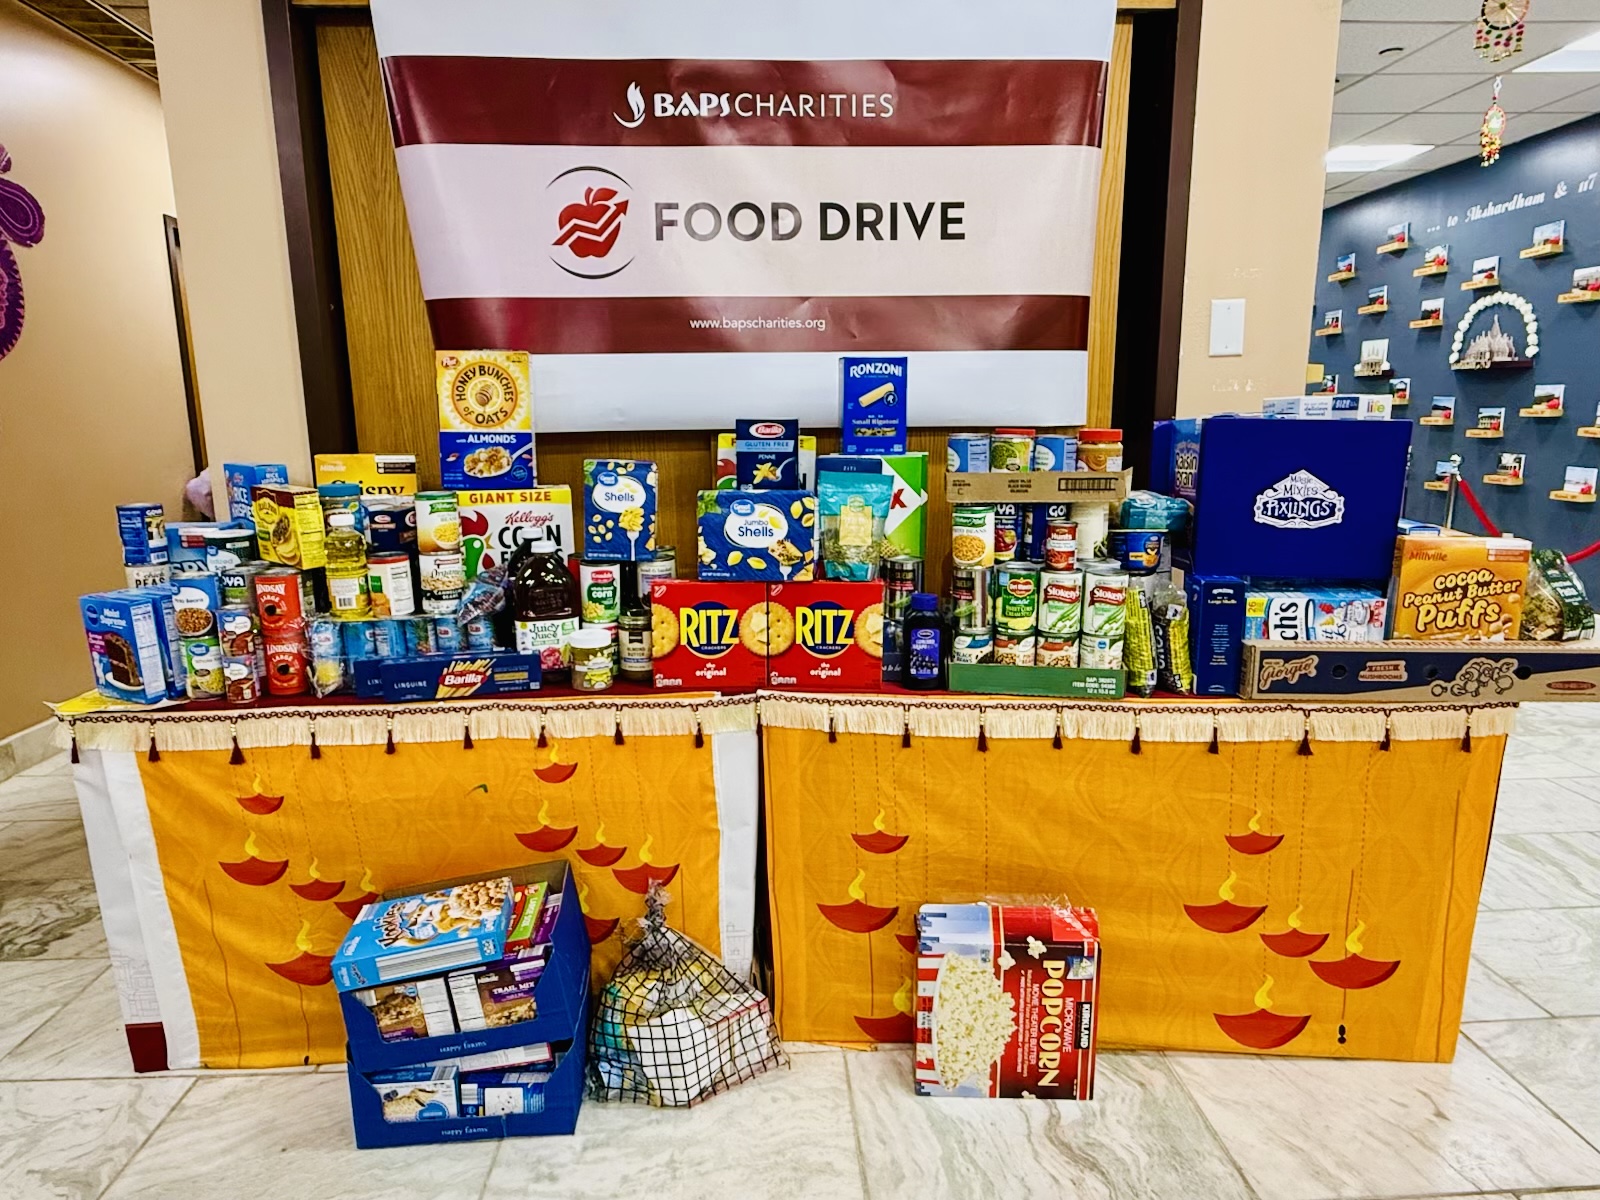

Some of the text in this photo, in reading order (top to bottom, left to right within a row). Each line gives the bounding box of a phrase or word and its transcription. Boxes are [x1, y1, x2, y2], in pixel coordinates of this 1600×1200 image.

[1554, 181, 1568, 199] &
[654, 202, 966, 241] FOOD DRIVE
[690, 316, 826, 332] www.bapscharities.org
[850, 363, 903, 378] RONZONI
[456, 365, 514, 403] HONEY BUNCHES
[463, 406, 508, 424] of OATS
[1367, 401, 1385, 413] life
[467, 434, 517, 443] ALMONDS
[469, 491, 552, 504] GIANT SIZE
[604, 492, 635, 502] Shells
[505, 510, 554, 528] Kellogg's
[498, 525, 562, 549] CON
[738, 526, 774, 537] Shells
[1408, 551, 1448, 561] Millville
[1435, 569, 1493, 590] cocoa
[592, 590, 613, 598] corn
[1404, 581, 1521, 607] Peanut Butter
[1274, 602, 1298, 640] ch's
[1416, 599, 1501, 632] Puffs
[529, 623, 560, 634] Juicy
[679, 607, 739, 647] RITZ
[795, 606, 854, 646] RITZ
[531, 631, 558, 640] Juice
[266, 643, 299, 654] LINDSAY
[444, 673, 483, 685] Barilla
[695, 667, 727, 678] original
[810, 667, 841, 678] original
[1261, 658, 1314, 688] Giorgio
[394, 681, 428, 689] LINGUINE
[493, 982, 535, 994] TRAIL MIX
[1030, 1007, 1038, 1037] THEATER
[1038, 960, 1066, 1087] POPCORN
[1063, 997, 1074, 1053] MICROWAVE
[1080, 1003, 1090, 1048] KIRKLAND
[1029, 1038, 1037, 1065] BUTTER
